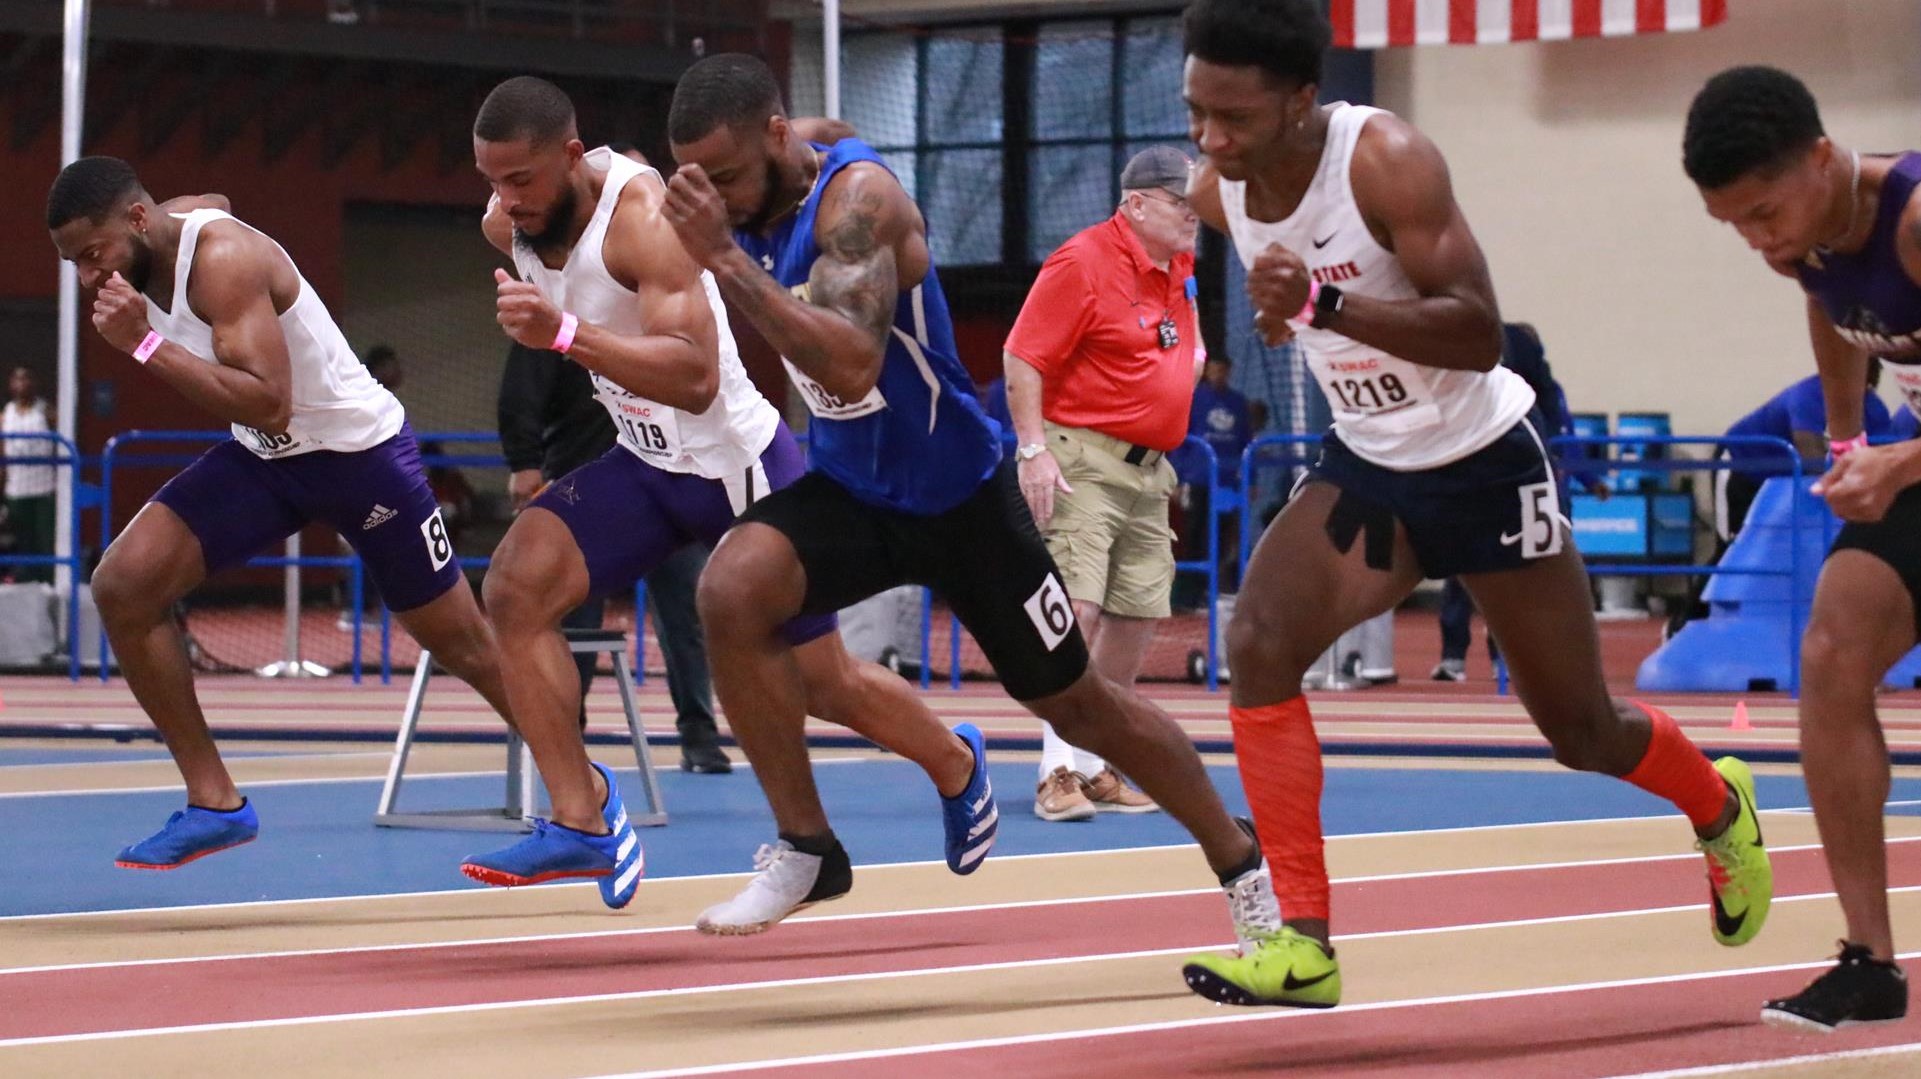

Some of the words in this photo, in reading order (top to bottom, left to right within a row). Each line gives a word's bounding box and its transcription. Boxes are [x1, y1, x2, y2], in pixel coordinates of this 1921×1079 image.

[1330, 373, 1407, 408] 1219
[621, 403, 651, 417] SWAC
[618, 414, 667, 450] 1119
[362, 509, 399, 530] adidas
[1531, 488, 1553, 553] 5
[428, 515, 449, 562] 8
[1040, 584, 1068, 636] 6
